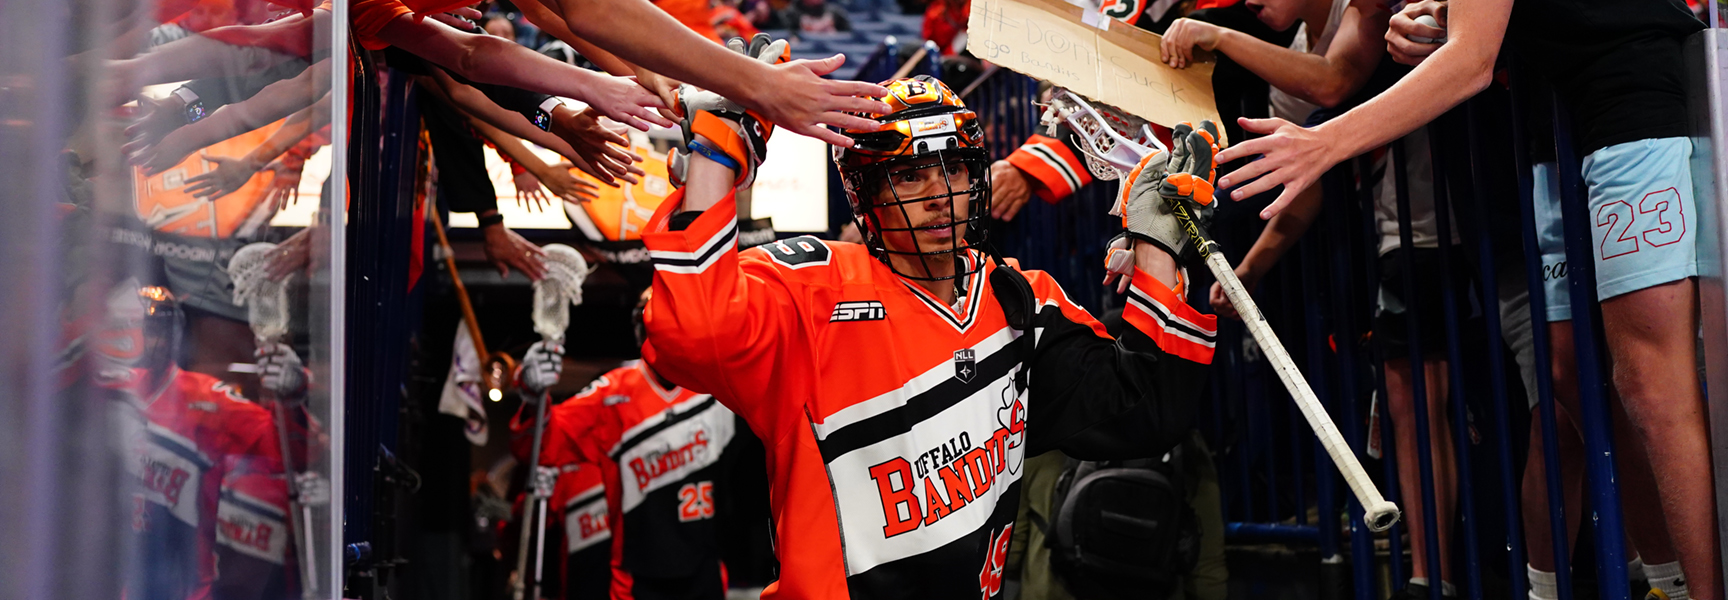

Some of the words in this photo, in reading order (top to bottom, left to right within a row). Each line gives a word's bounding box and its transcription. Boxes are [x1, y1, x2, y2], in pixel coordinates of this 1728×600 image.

[984, 38, 1011, 59] go
[1020, 50, 1081, 82] Bandits
[1110, 55, 1187, 104] Suck
[906, 81, 927, 98] B
[1596, 186, 1687, 261] 23
[829, 301, 885, 323] ESPN
[955, 351, 974, 361] NLL
[868, 398, 1025, 539] BANDITS
[678, 480, 715, 522] 25
